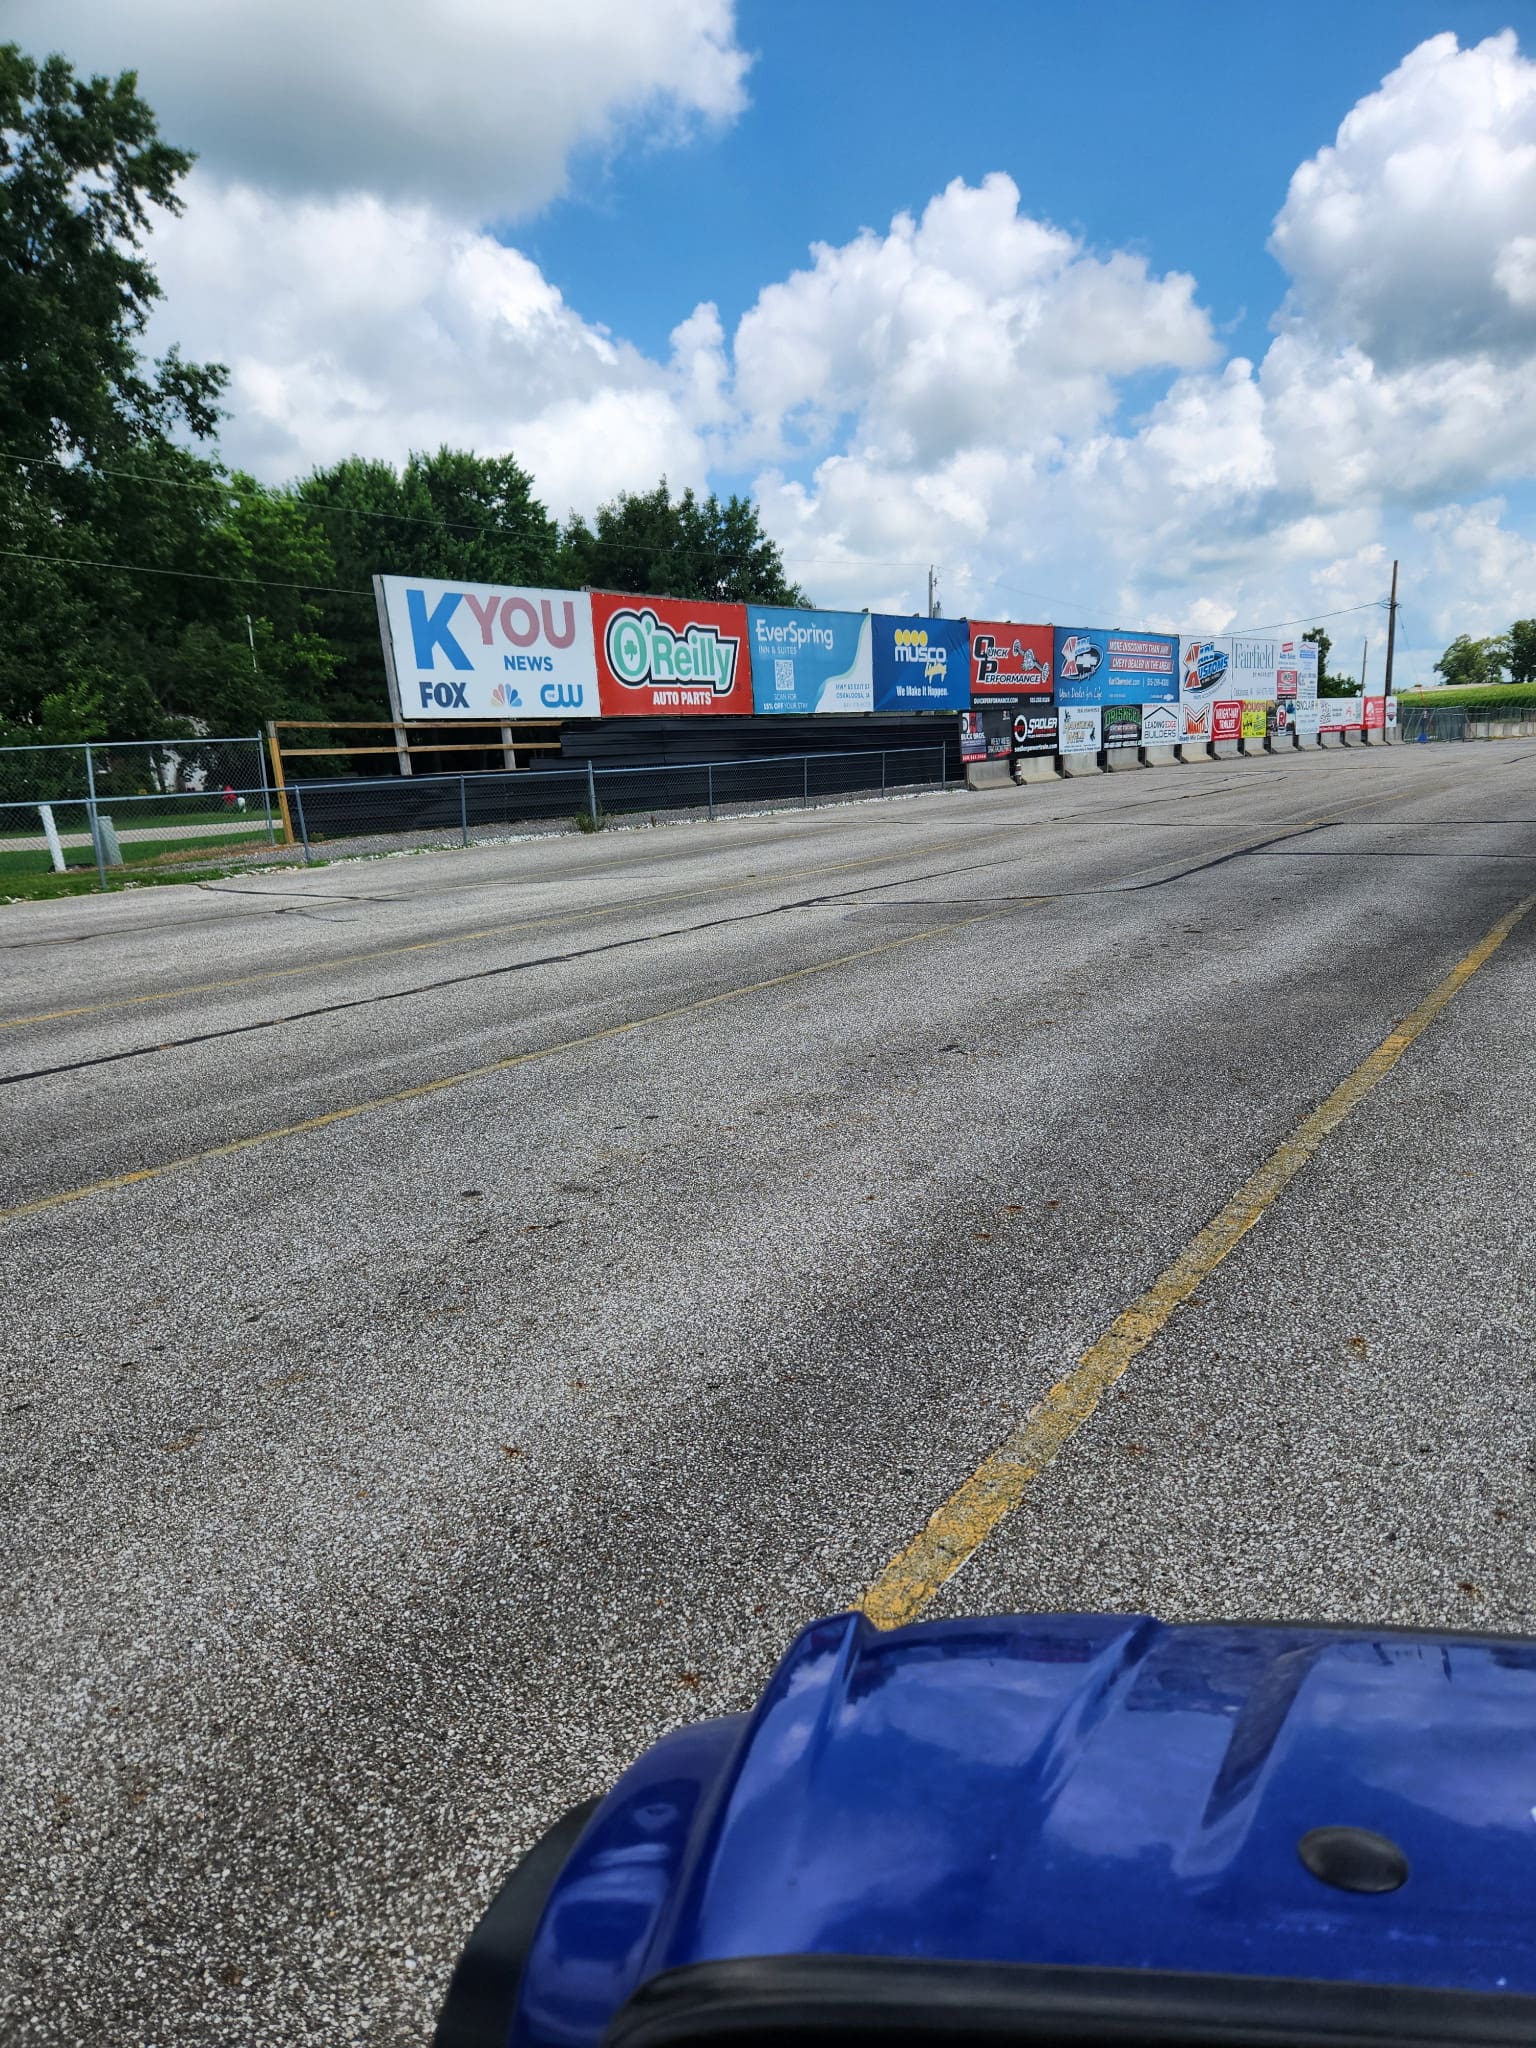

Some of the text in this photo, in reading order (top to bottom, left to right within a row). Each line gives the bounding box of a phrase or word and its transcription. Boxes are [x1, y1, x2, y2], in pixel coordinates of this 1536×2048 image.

[406, 589, 576, 671] KYOU
[755, 619, 834, 651] EverSpring
[610, 616, 735, 690] O'Reilly
[758, 645, 770, 656] INN
[777, 646, 798, 656] SUITES
[1234, 643, 1274, 670] Fairfield
[503, 655, 554, 672] NEWS
[419, 681, 471, 709] FOX
[540, 683, 584, 709] CW
[653, 691, 712, 706] AUTO PARTS
[896, 686, 906, 697] We
[906, 686, 922, 697] Make
[774, 702, 784, 710] OFF
[1027, 717, 1058, 734] SADLER
[1144, 720, 1165, 729] LEADING
[1165, 720, 1177, 728] EDGE
[1144, 730, 1177, 739] BUILDERS
